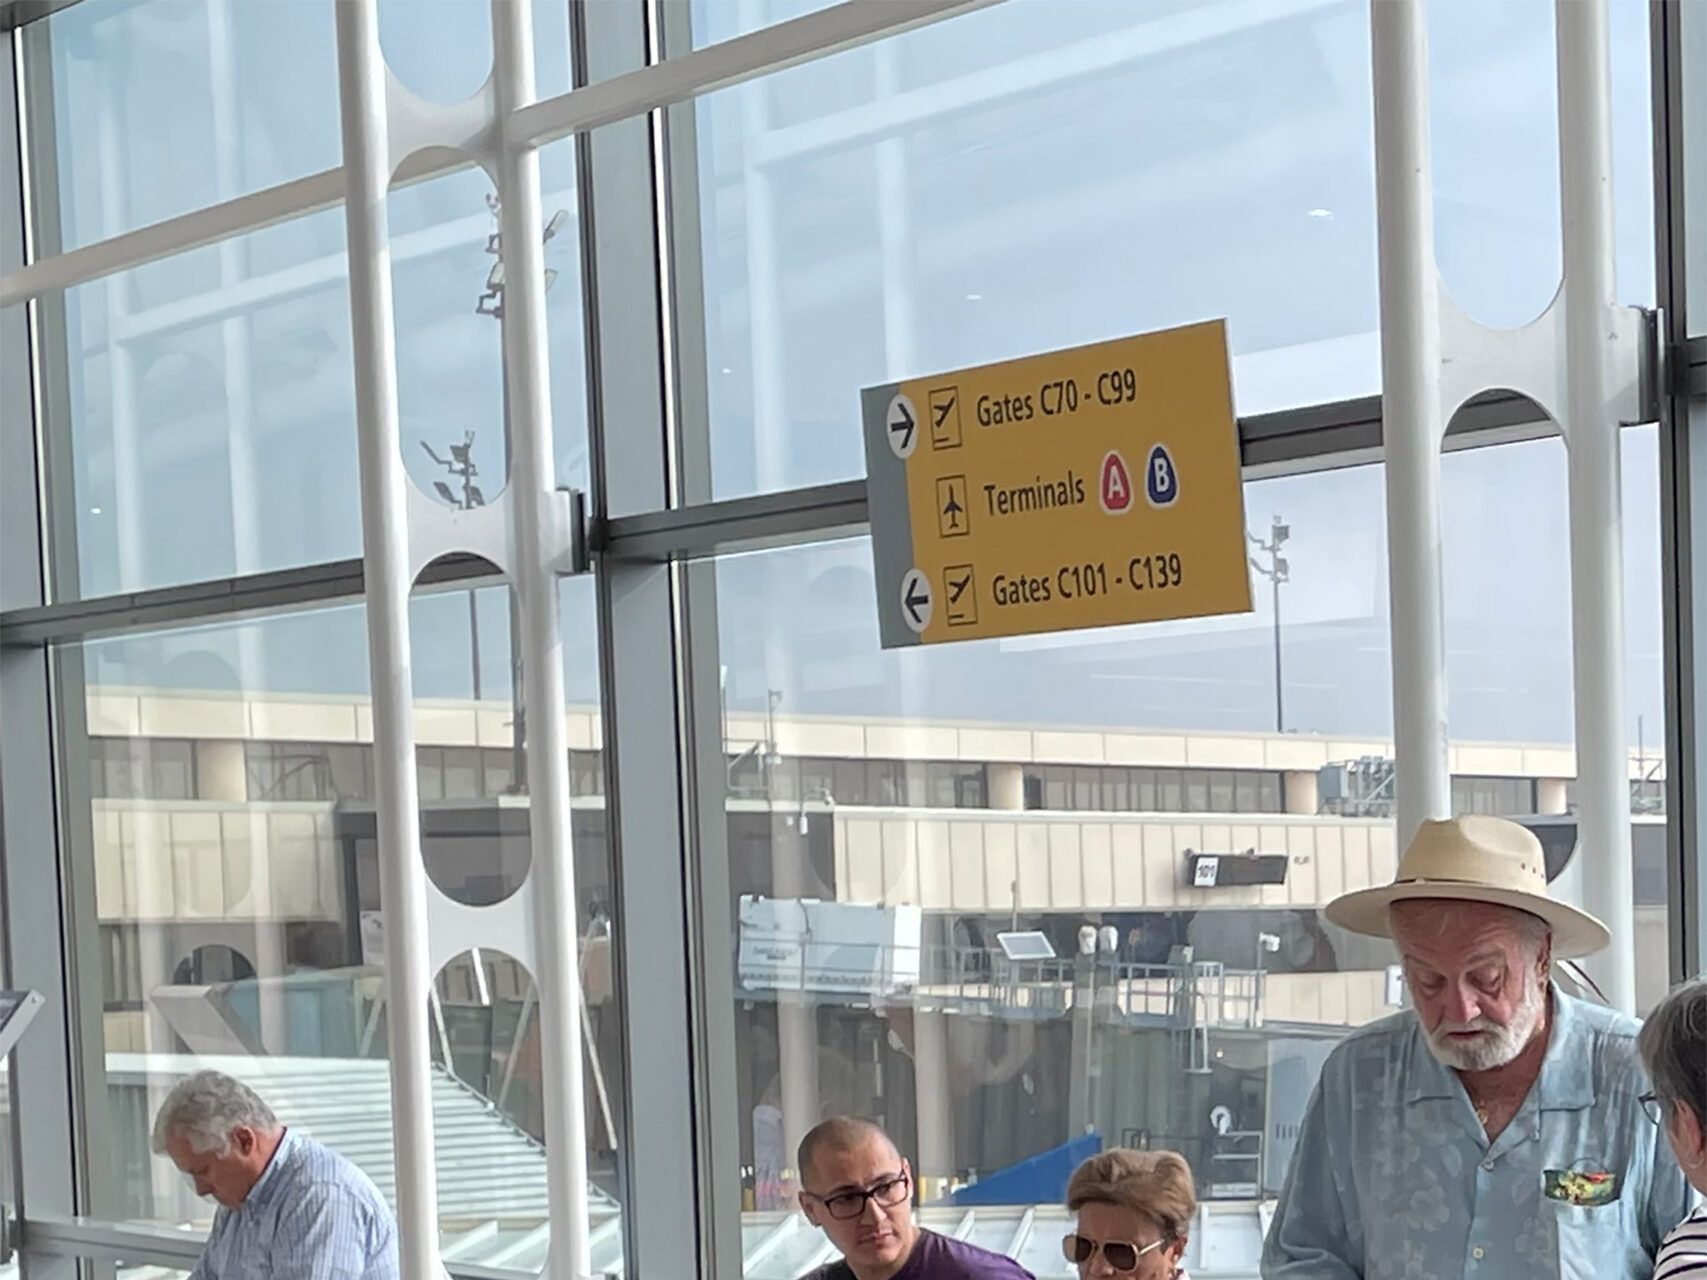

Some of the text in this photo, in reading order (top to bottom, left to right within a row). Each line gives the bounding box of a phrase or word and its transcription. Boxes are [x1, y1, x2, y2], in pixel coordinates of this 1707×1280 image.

[977, 393, 1034, 427] Gates
[1041, 379, 1078, 415] C70
[1097, 368, 1136, 405] C99
[983, 457, 1170, 517] Terminals A B
[992, 575, 1052, 606] Gates
[1058, 562, 1108, 599] C101
[1129, 553, 1182, 590] C139
